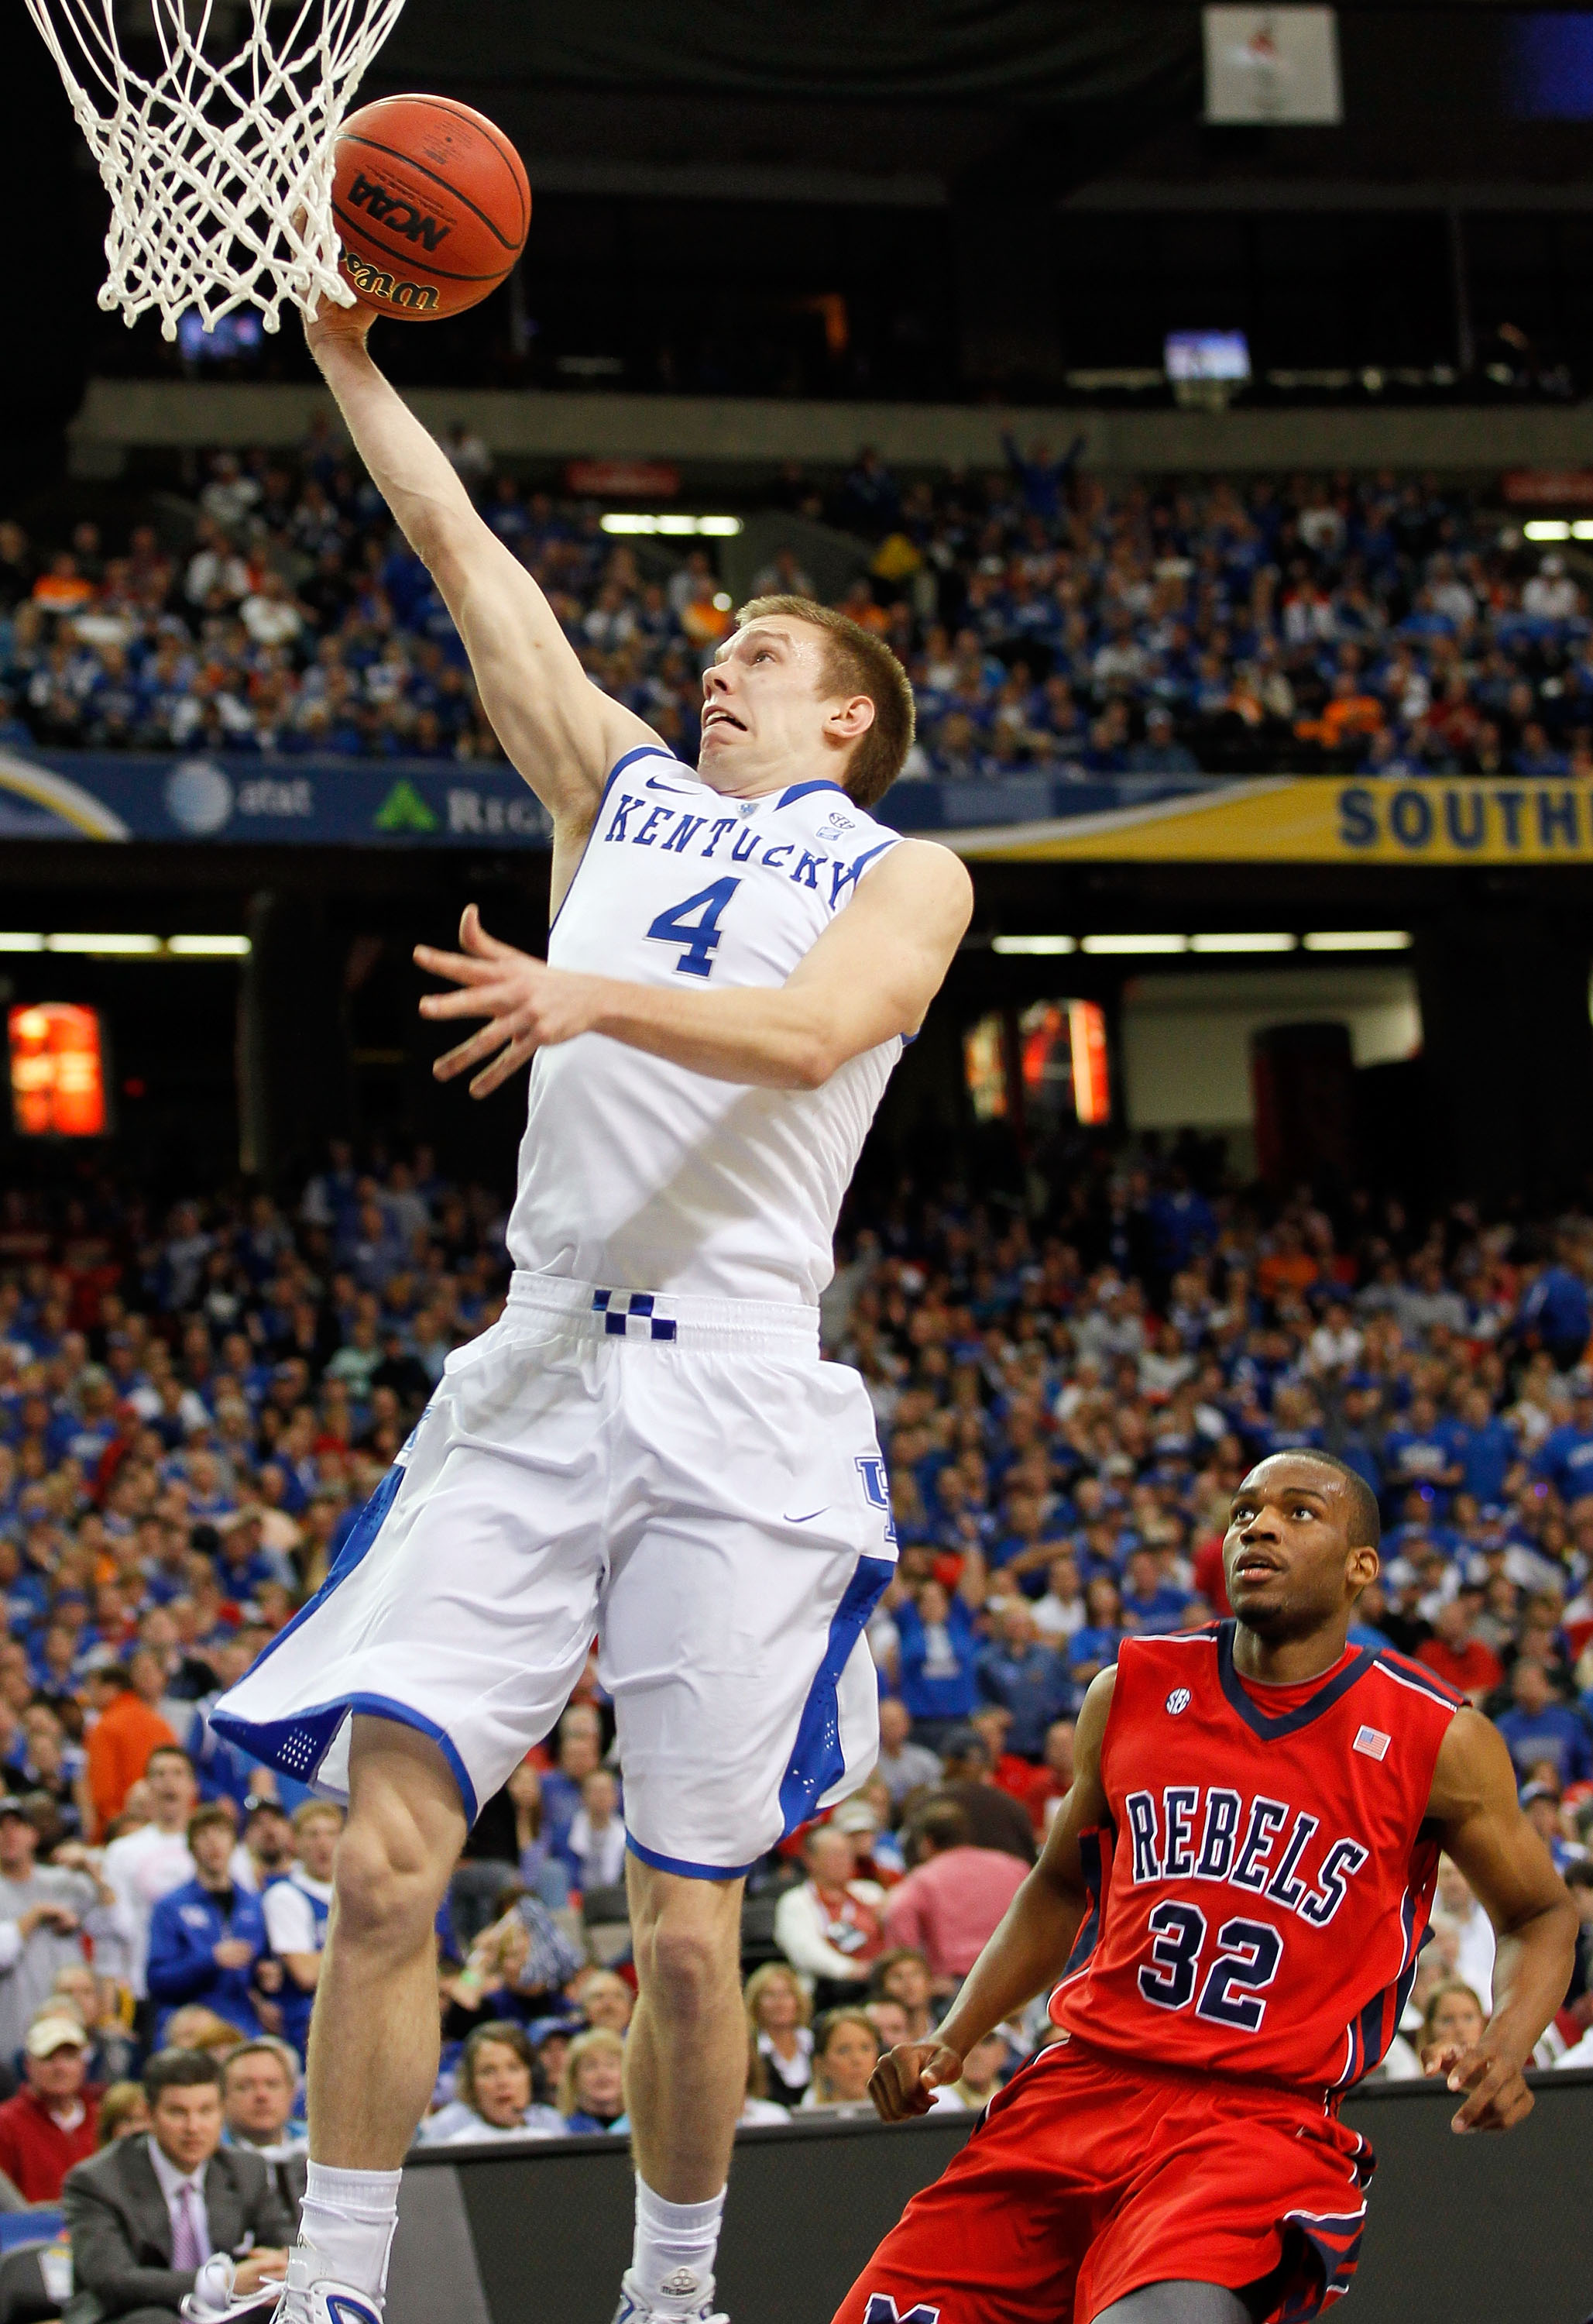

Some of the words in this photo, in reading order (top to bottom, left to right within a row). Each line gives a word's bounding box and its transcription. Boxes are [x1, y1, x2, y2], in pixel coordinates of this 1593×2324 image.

[348, 172, 451, 252] NCAA
[339, 245, 440, 311] Wils
[604, 794, 856, 912] KENTUCKY
[1339, 788, 1593, 848] SOUTH
[642, 875, 743, 981] 4
[1166, 1687, 1192, 1715] SEC
[1125, 1786, 1369, 1929] REBELS
[1138, 1899, 1284, 2033] 32
